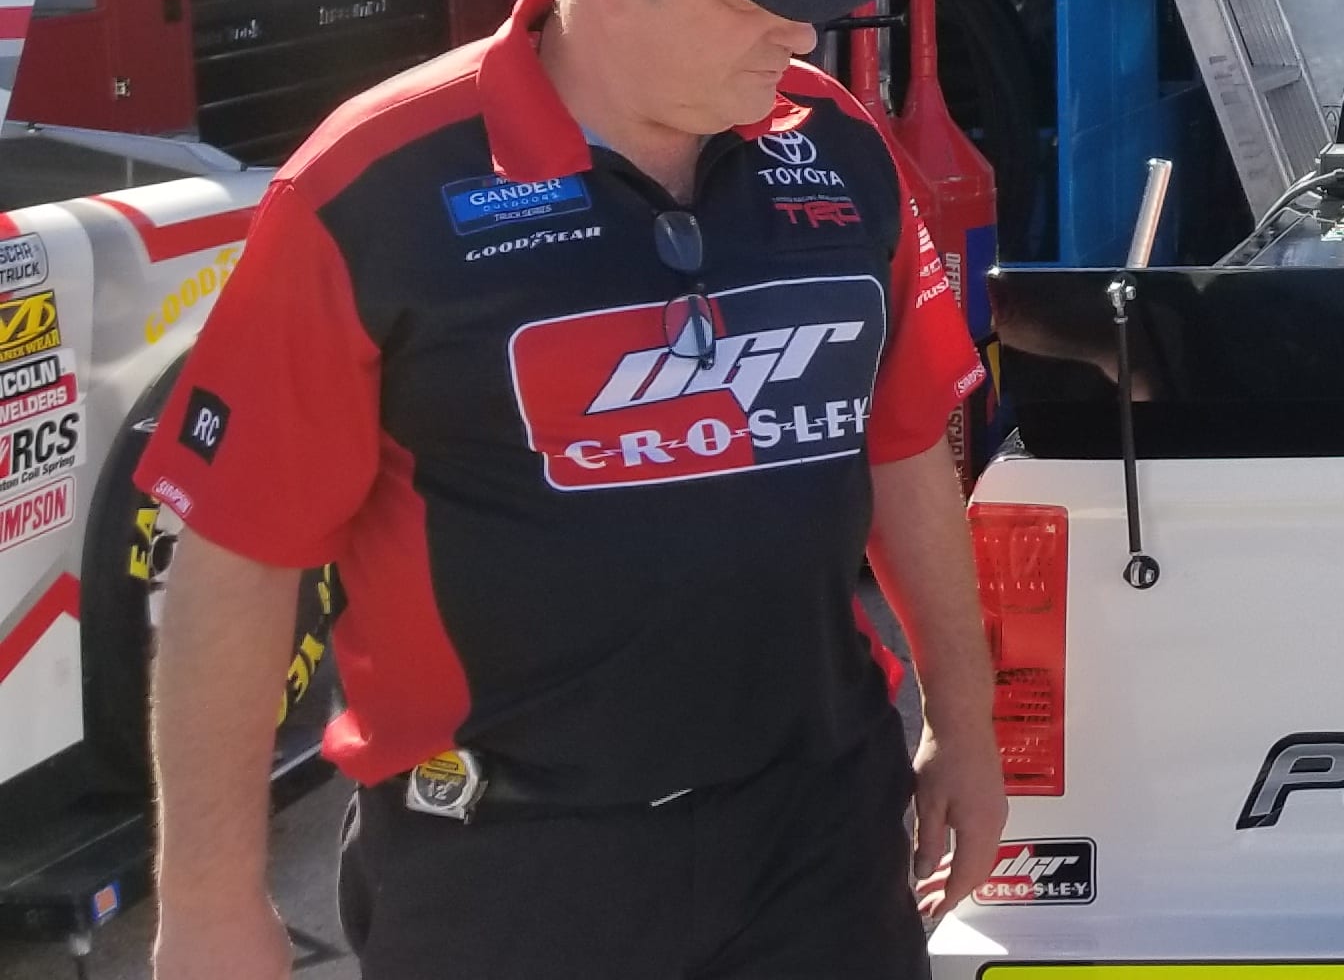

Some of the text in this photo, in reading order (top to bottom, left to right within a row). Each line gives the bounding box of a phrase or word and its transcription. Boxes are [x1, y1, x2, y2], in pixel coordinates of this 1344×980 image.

[469, 177, 562, 206] GANDER
[757, 166, 845, 188] TOYOTA
[464, 225, 602, 262] GOODYEAR
[11, 412, 80, 474] RCS
[192, 407, 220, 447] RC
[563, 396, 871, 470] CROSLEY
[42, 454, 76, 476] Spring
[980, 881, 1089, 897] CROSLEY
